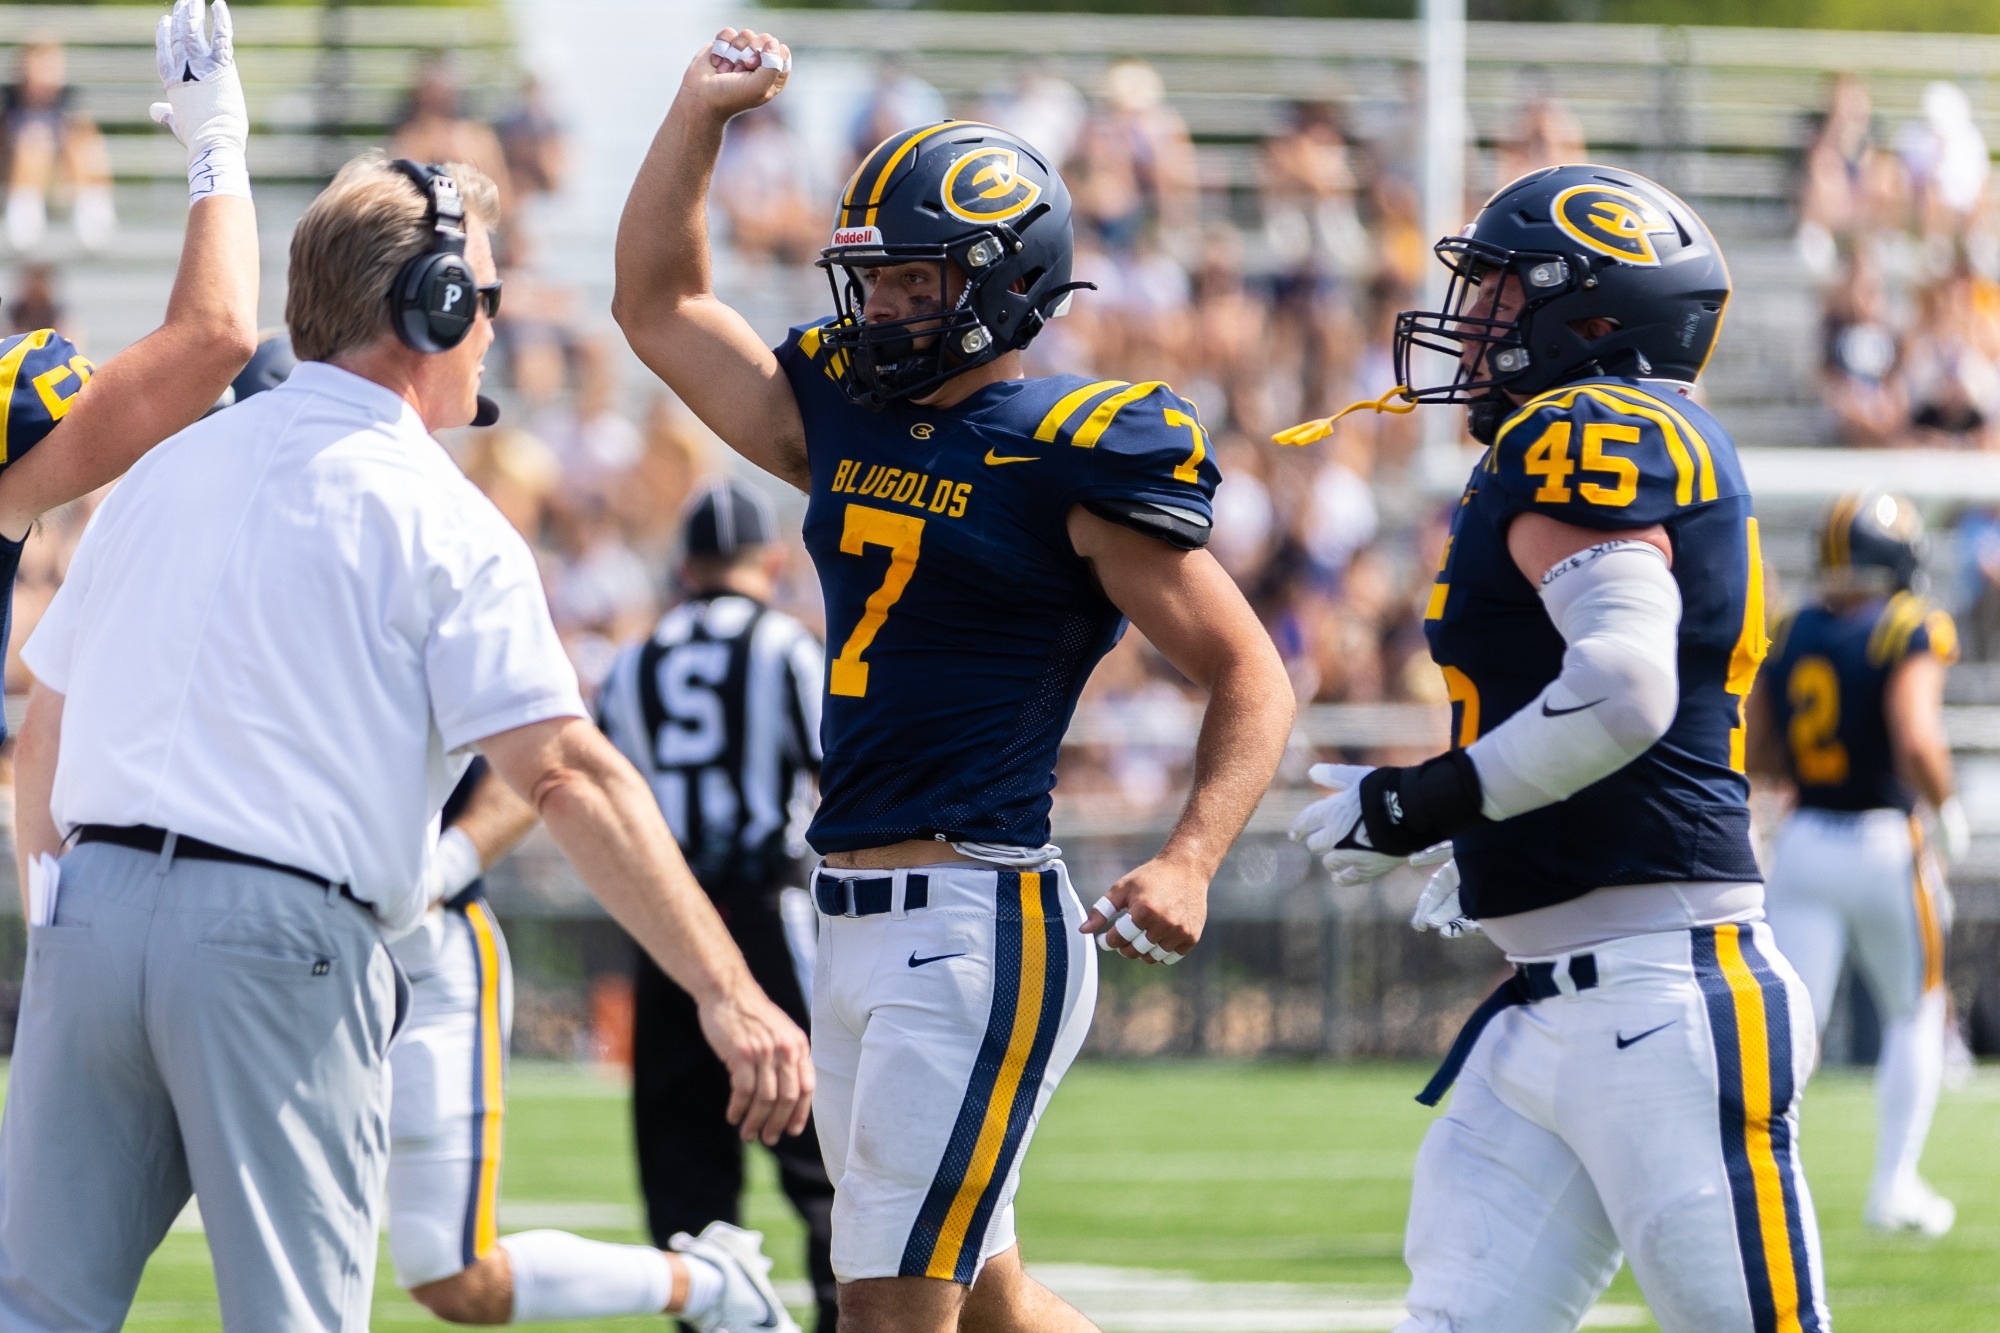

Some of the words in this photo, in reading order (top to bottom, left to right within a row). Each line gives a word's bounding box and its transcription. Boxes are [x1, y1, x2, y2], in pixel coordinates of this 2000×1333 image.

[834, 230, 873, 244] Riddell
[442, 283, 462, 312] P
[1163, 408, 1205, 484] 7
[1524, 421, 1640, 507] 45
[831, 459, 973, 518] BLUGOLDS
[829, 503, 926, 698] 7
[656, 642, 730, 765] S
[1789, 658, 1847, 784] 2
